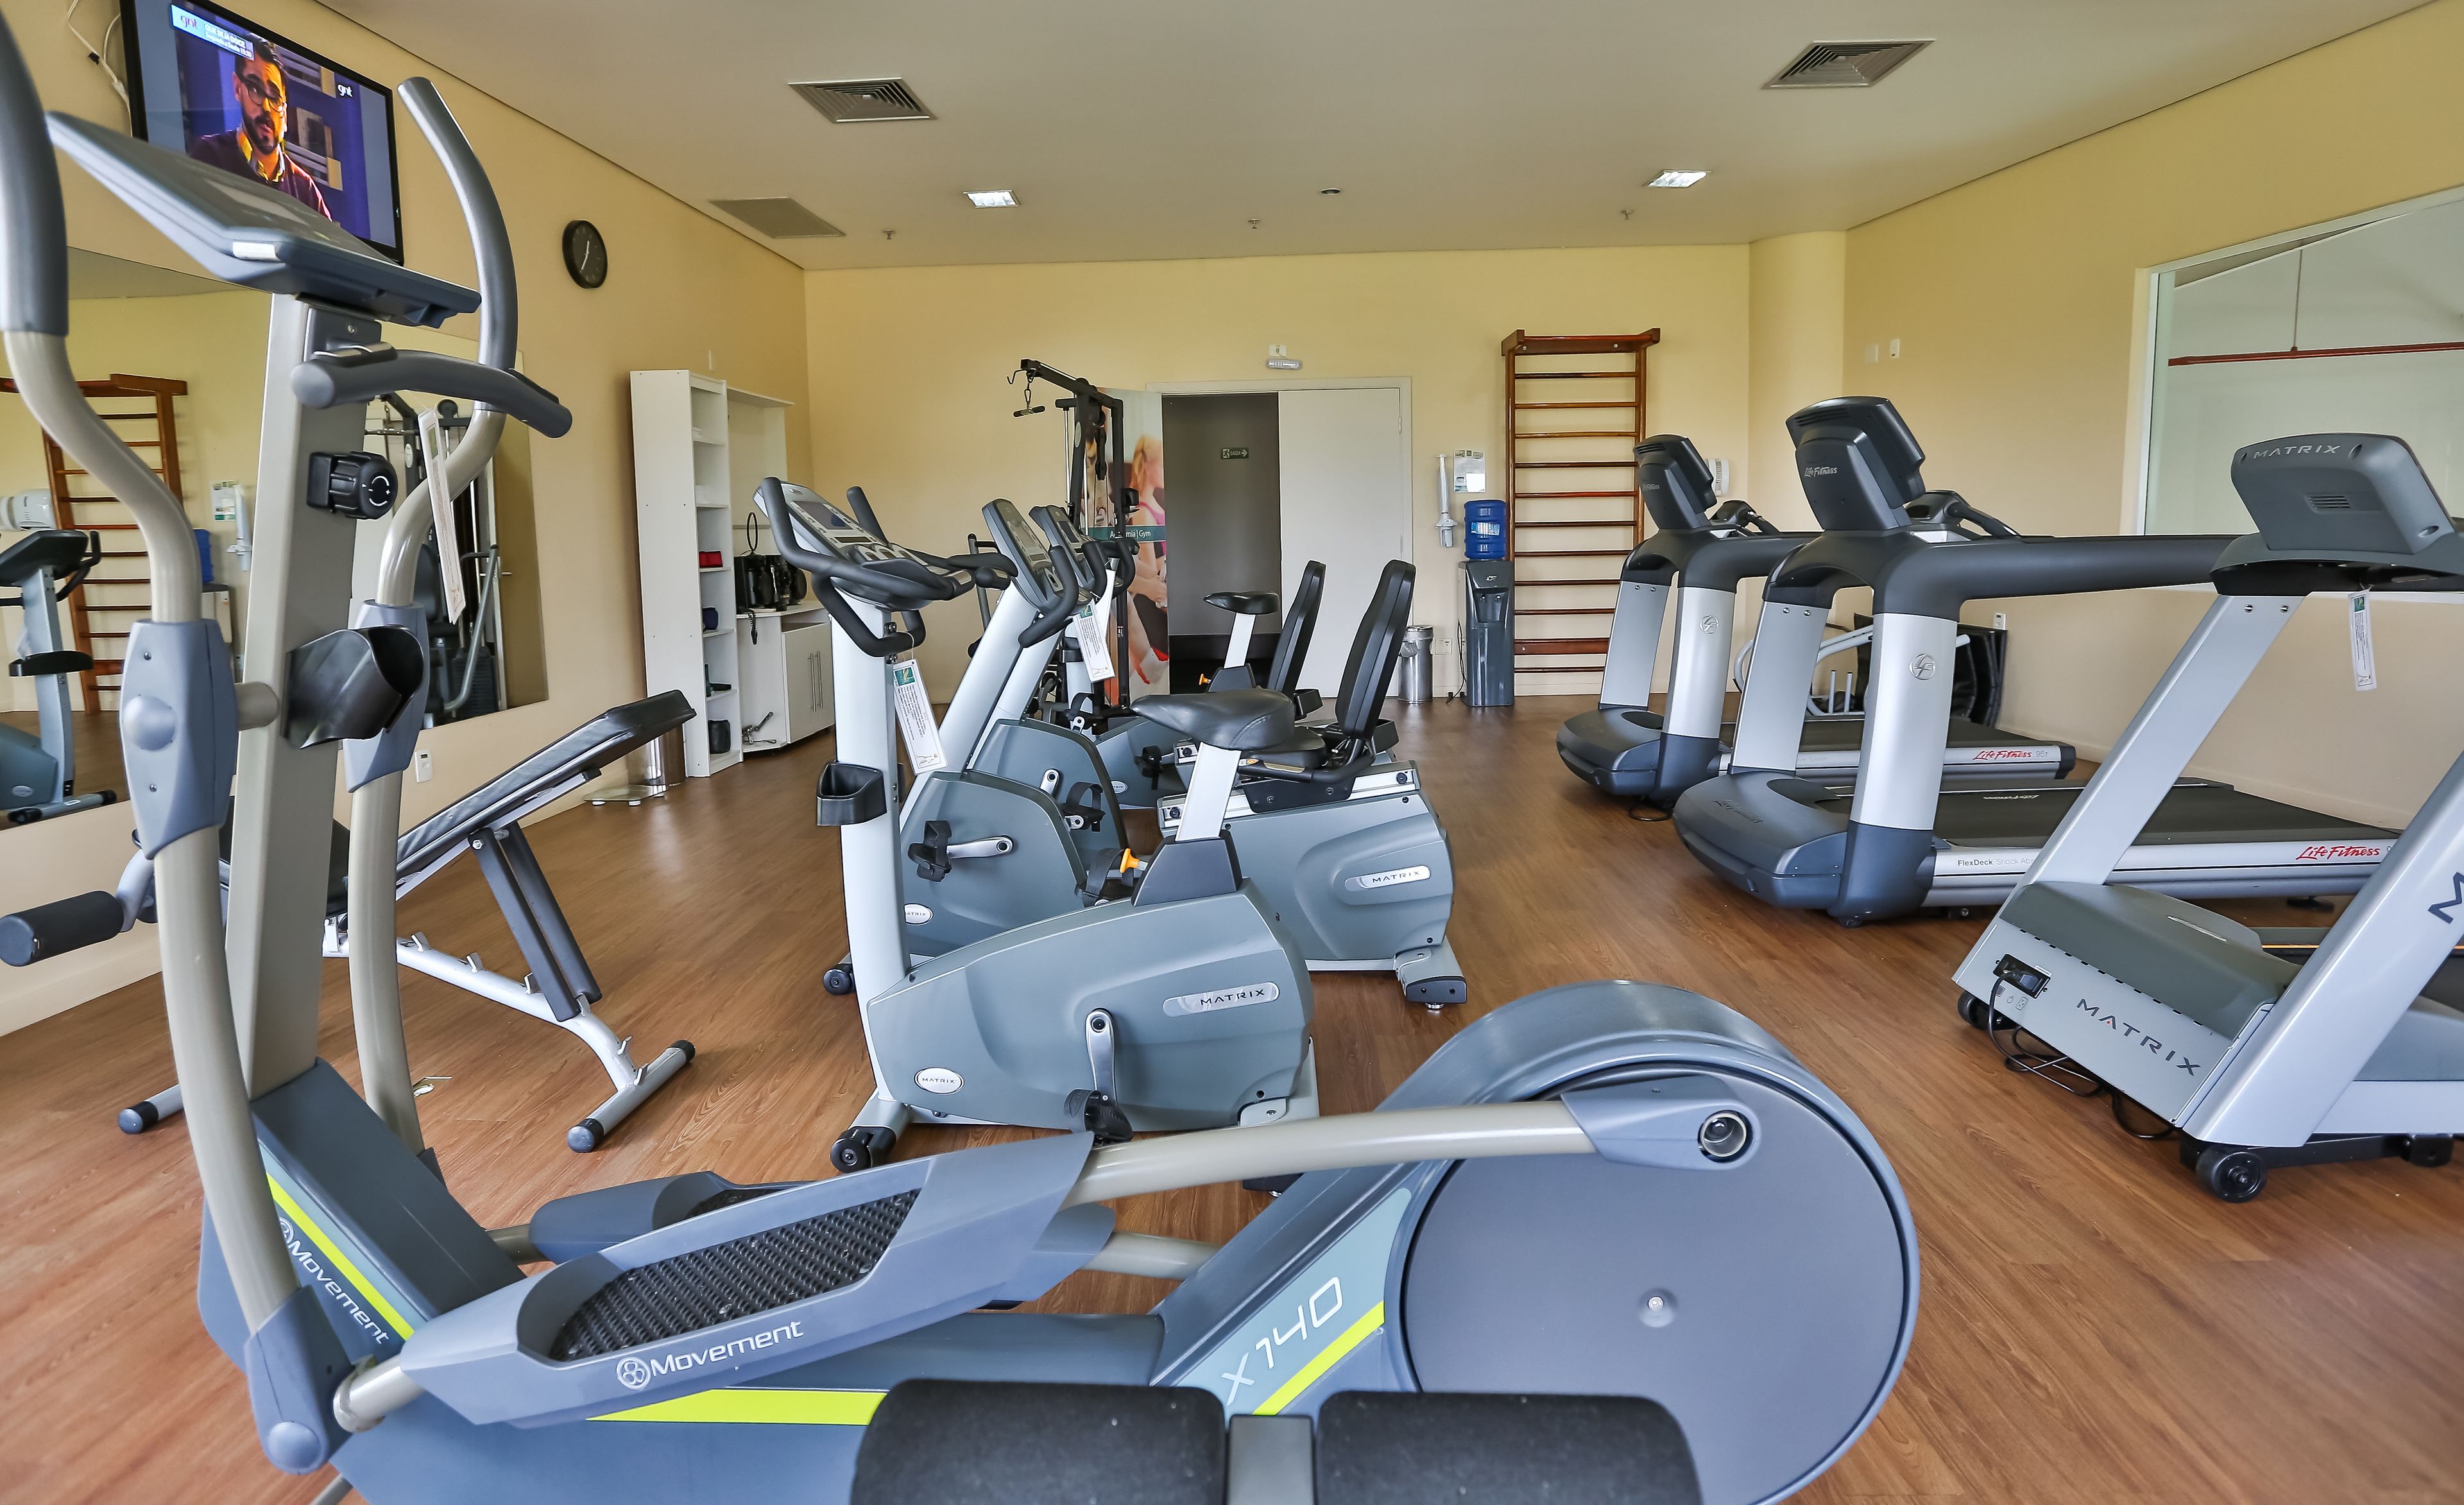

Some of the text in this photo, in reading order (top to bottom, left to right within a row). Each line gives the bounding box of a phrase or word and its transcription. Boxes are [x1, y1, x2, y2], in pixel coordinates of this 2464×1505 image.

[338, 84, 353, 98] gnt
[2253, 444, 2341, 459] MATRIX
[1372, 870, 1420, 883] MATRIX
[1200, 989, 1265, 1006] MATRIX
[2076, 998, 2202, 1077] MATRIX
[288, 1239, 390, 1345] Movement
[649, 1320, 805, 1378] Movement
